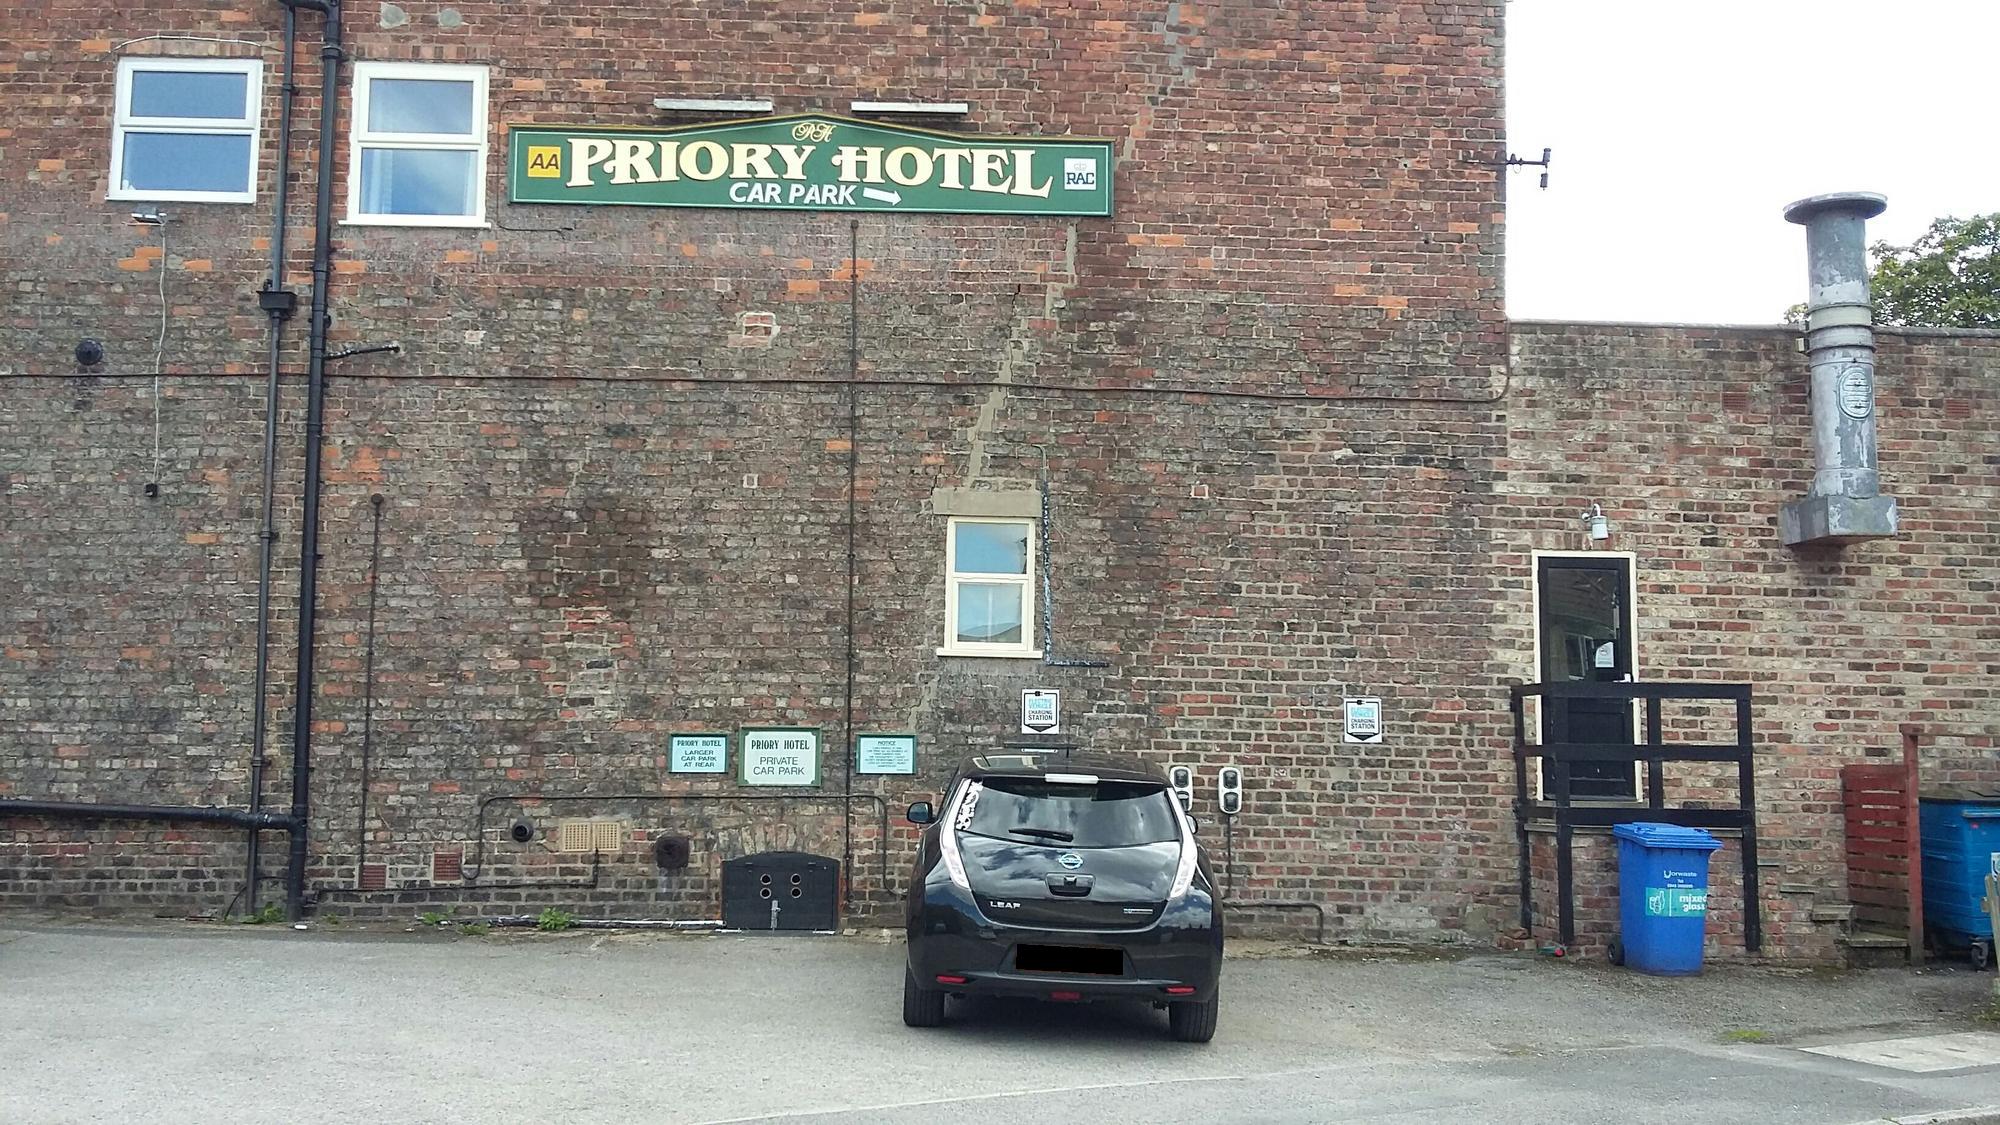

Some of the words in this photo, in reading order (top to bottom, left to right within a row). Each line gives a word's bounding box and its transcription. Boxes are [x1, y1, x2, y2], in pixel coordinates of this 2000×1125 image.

[530, 153, 560, 170] AA
[565, 138, 816, 187] PRIORY
[831, 146, 1053, 199] HOTEL
[1066, 172, 1095, 185] RAC
[729, 181, 782, 203] CAR
[788, 183, 858, 206] PARK
[751, 739, 779, 750] PRIORY
[784, 739, 810, 750] HOTEL
[760, 756, 799, 765] PRIVATE
[753, 766, 775, 775] CAR
[778, 766, 806, 775] PARK
[1679, 893, 1708, 903] mixed
[990, 900, 1021, 909] LEAF
[1683, 903, 1706, 912] glass
